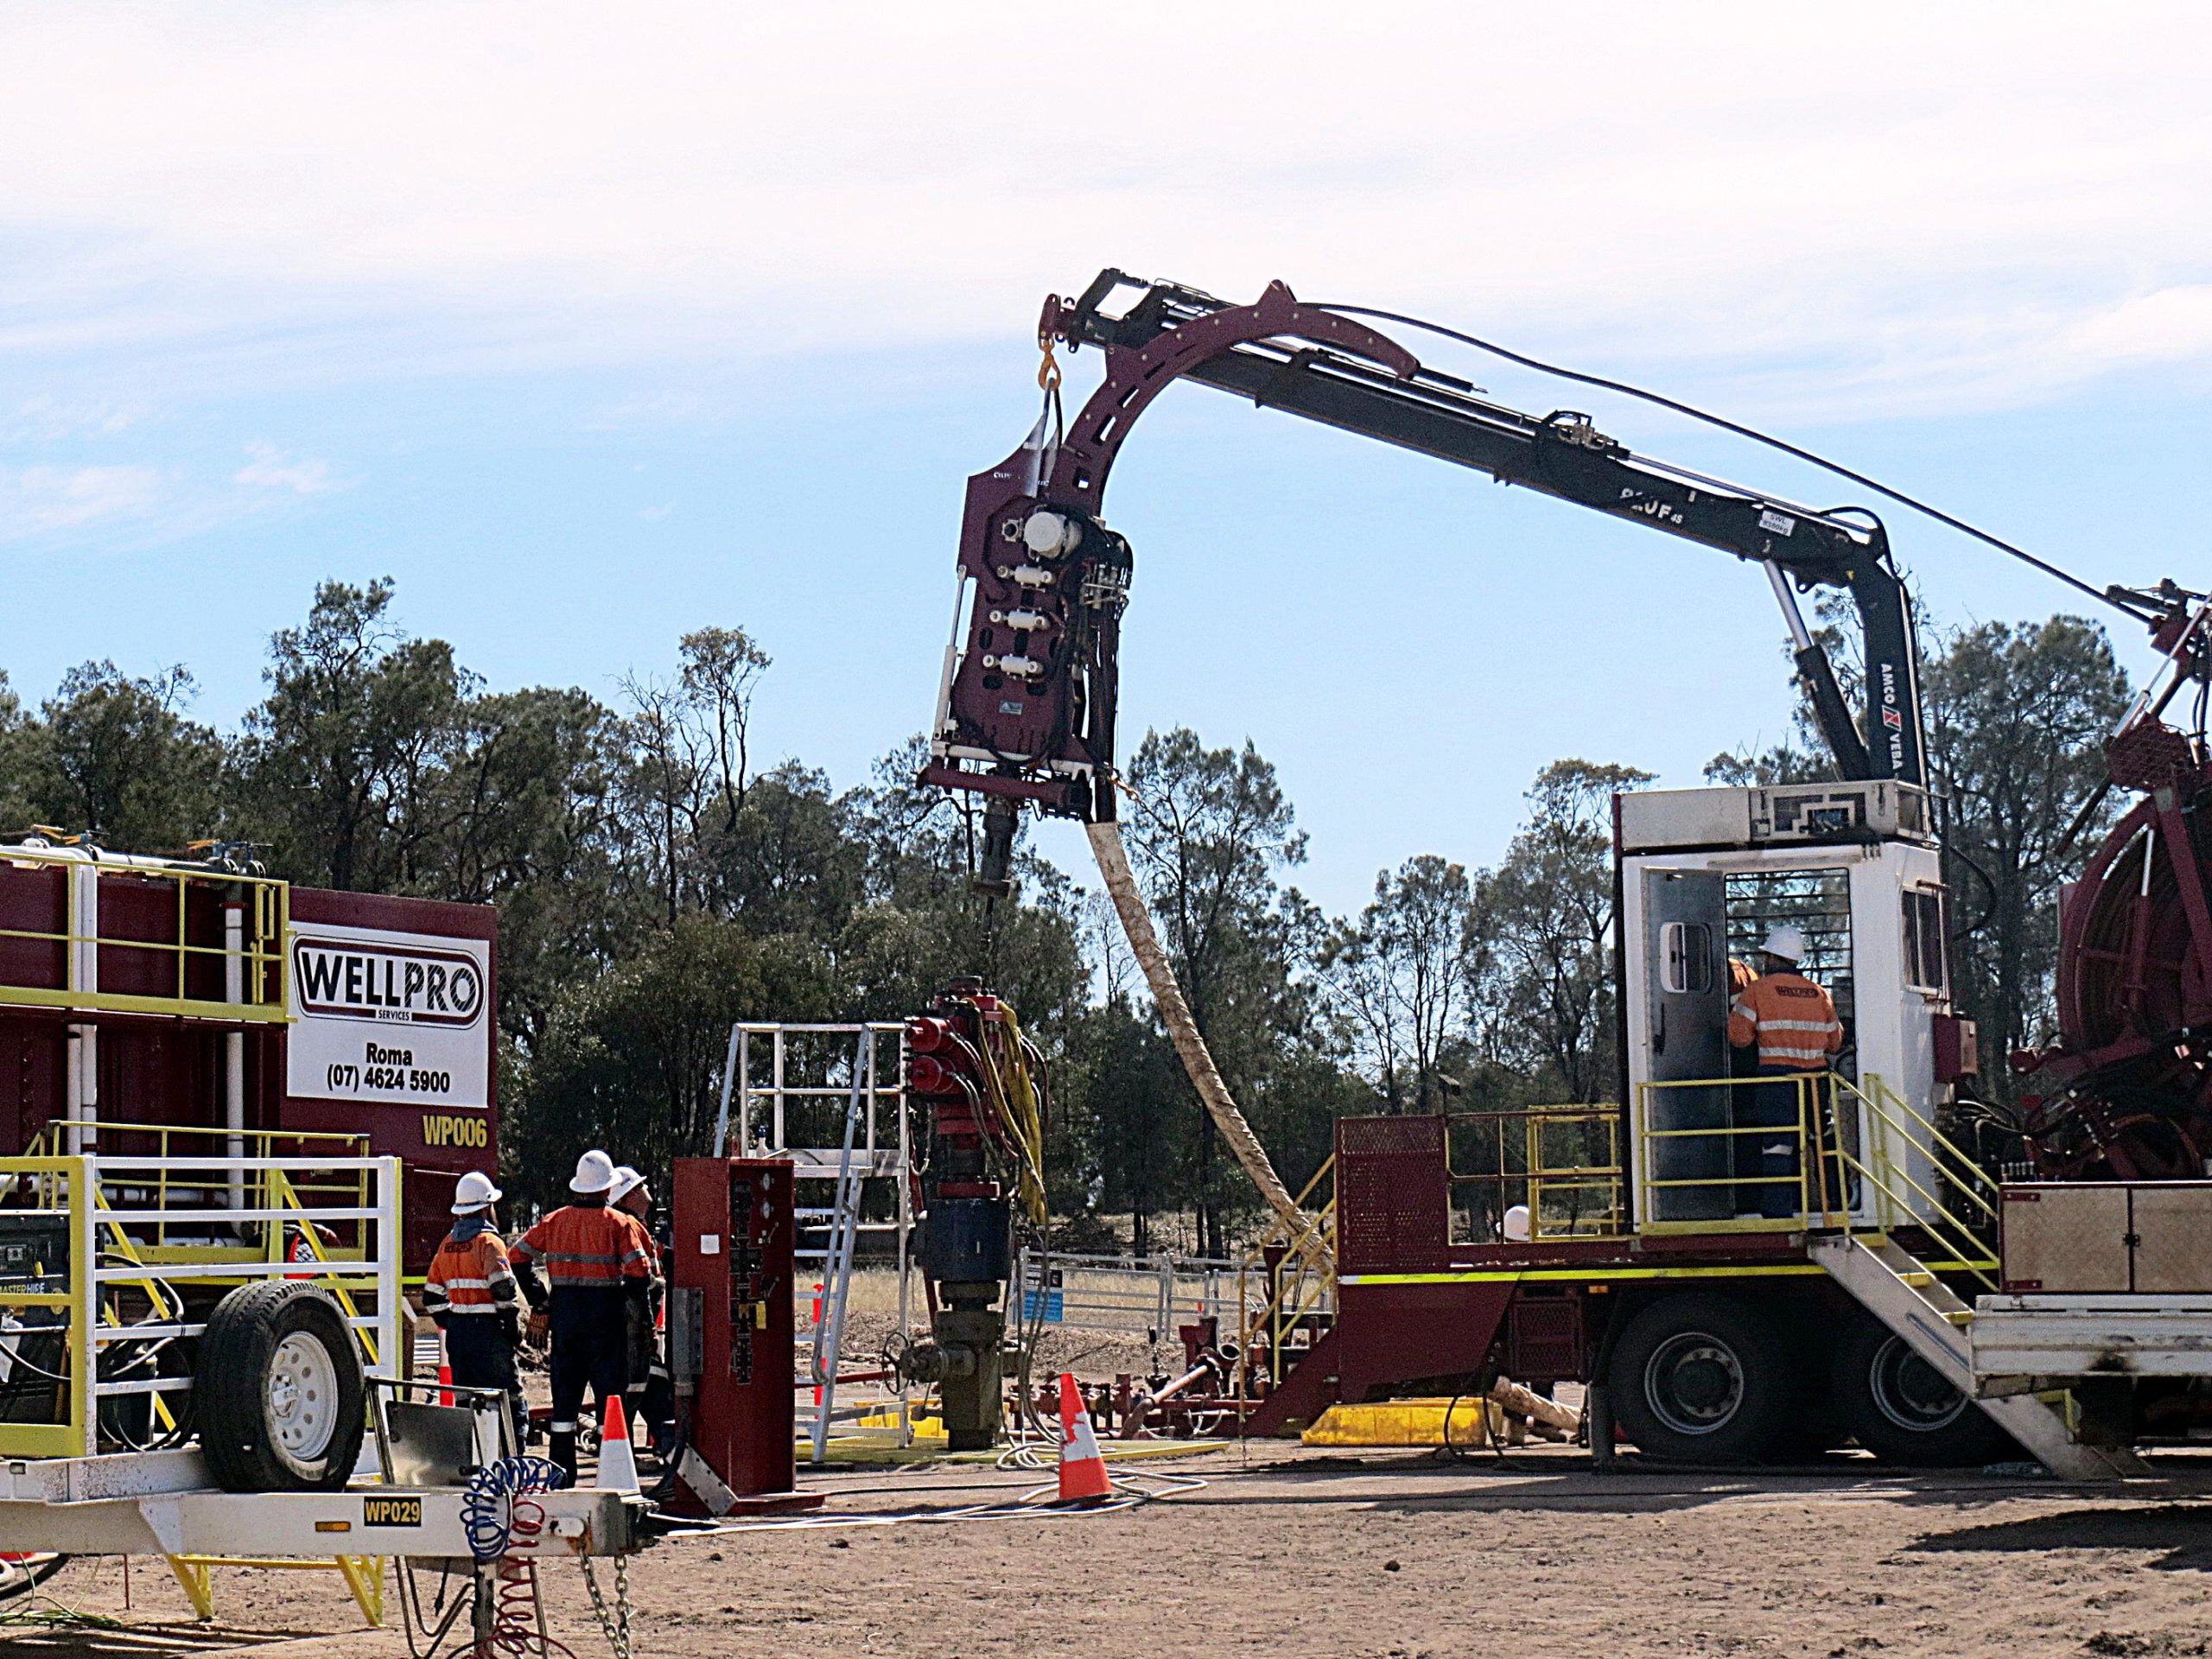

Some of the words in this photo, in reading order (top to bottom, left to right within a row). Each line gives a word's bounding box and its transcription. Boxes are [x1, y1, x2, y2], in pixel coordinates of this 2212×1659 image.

[1881, 664, 1896, 705] AMCO
[1889, 733, 1904, 770] VEBA
[301, 950, 477, 1013] WELLPRO
[378, 1009, 410, 1021] SERVICES
[365, 1042, 413, 1066] Roma
[327, 1064, 359, 1093] (07)
[364, 1067, 405, 1090] 4624
[410, 1070, 450, 1093] 5900
[423, 1115, 488, 1148] WP006
[365, 1501, 421, 1522] WP029
